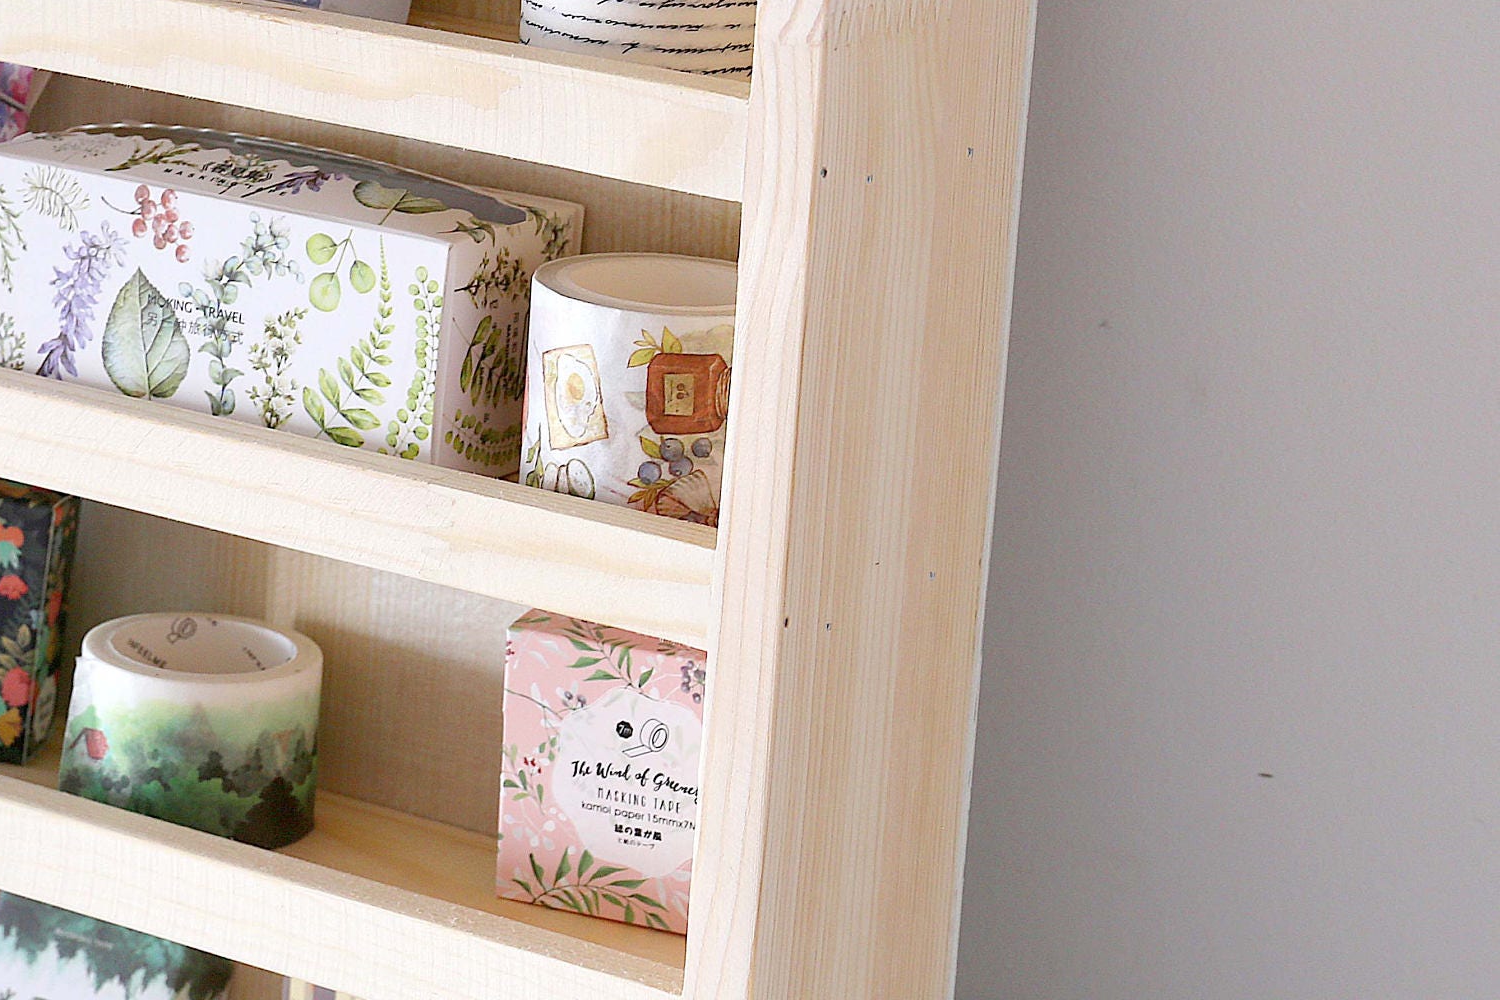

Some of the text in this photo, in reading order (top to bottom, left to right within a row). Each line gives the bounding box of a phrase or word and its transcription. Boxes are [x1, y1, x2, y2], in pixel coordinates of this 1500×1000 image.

[571, 760, 592, 778] The
[595, 762, 632, 780] Wind
[634, 767, 651, 787] of
[614, 808, 645, 822] paper
